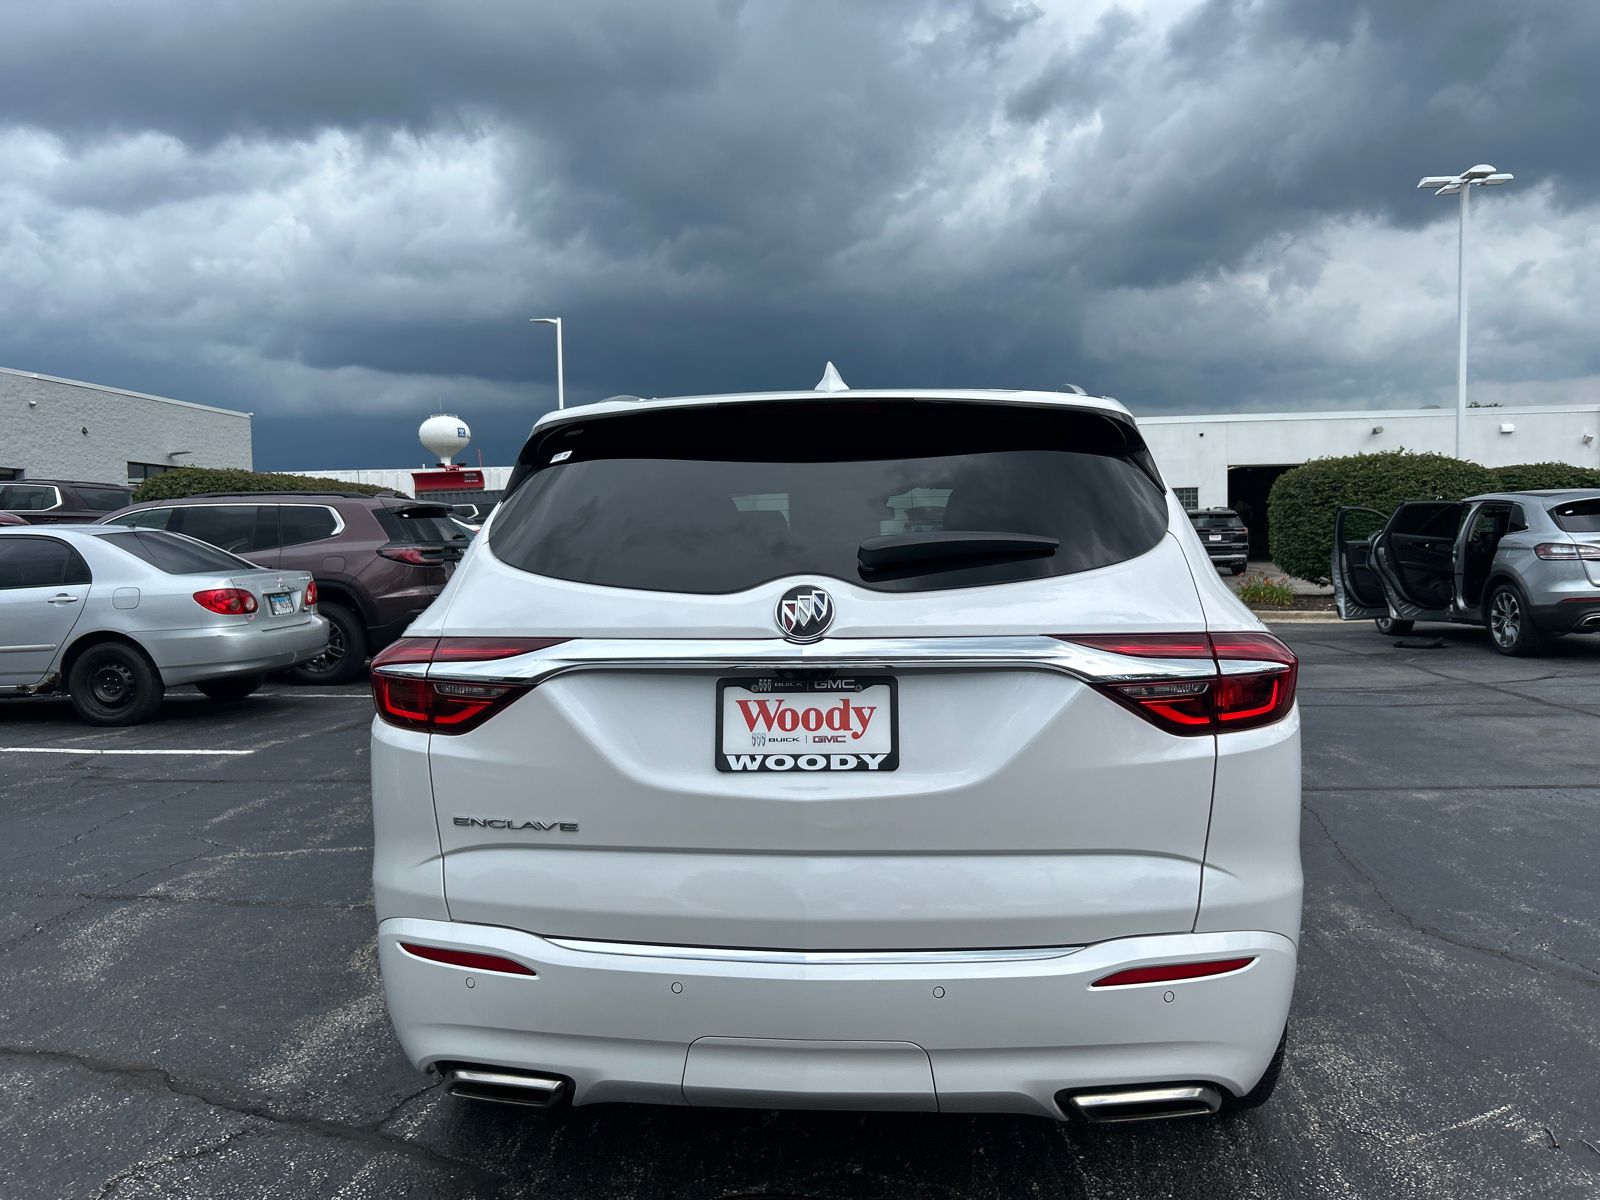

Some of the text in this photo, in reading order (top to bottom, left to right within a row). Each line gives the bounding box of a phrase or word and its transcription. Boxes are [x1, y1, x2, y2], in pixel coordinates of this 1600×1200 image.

[814, 679, 856, 690] GMC
[735, 698, 877, 740] Woody
[812, 735, 847, 744] GMC
[726, 754, 888, 771] WOODY
[452, 816, 580, 832] ENCLAVE
